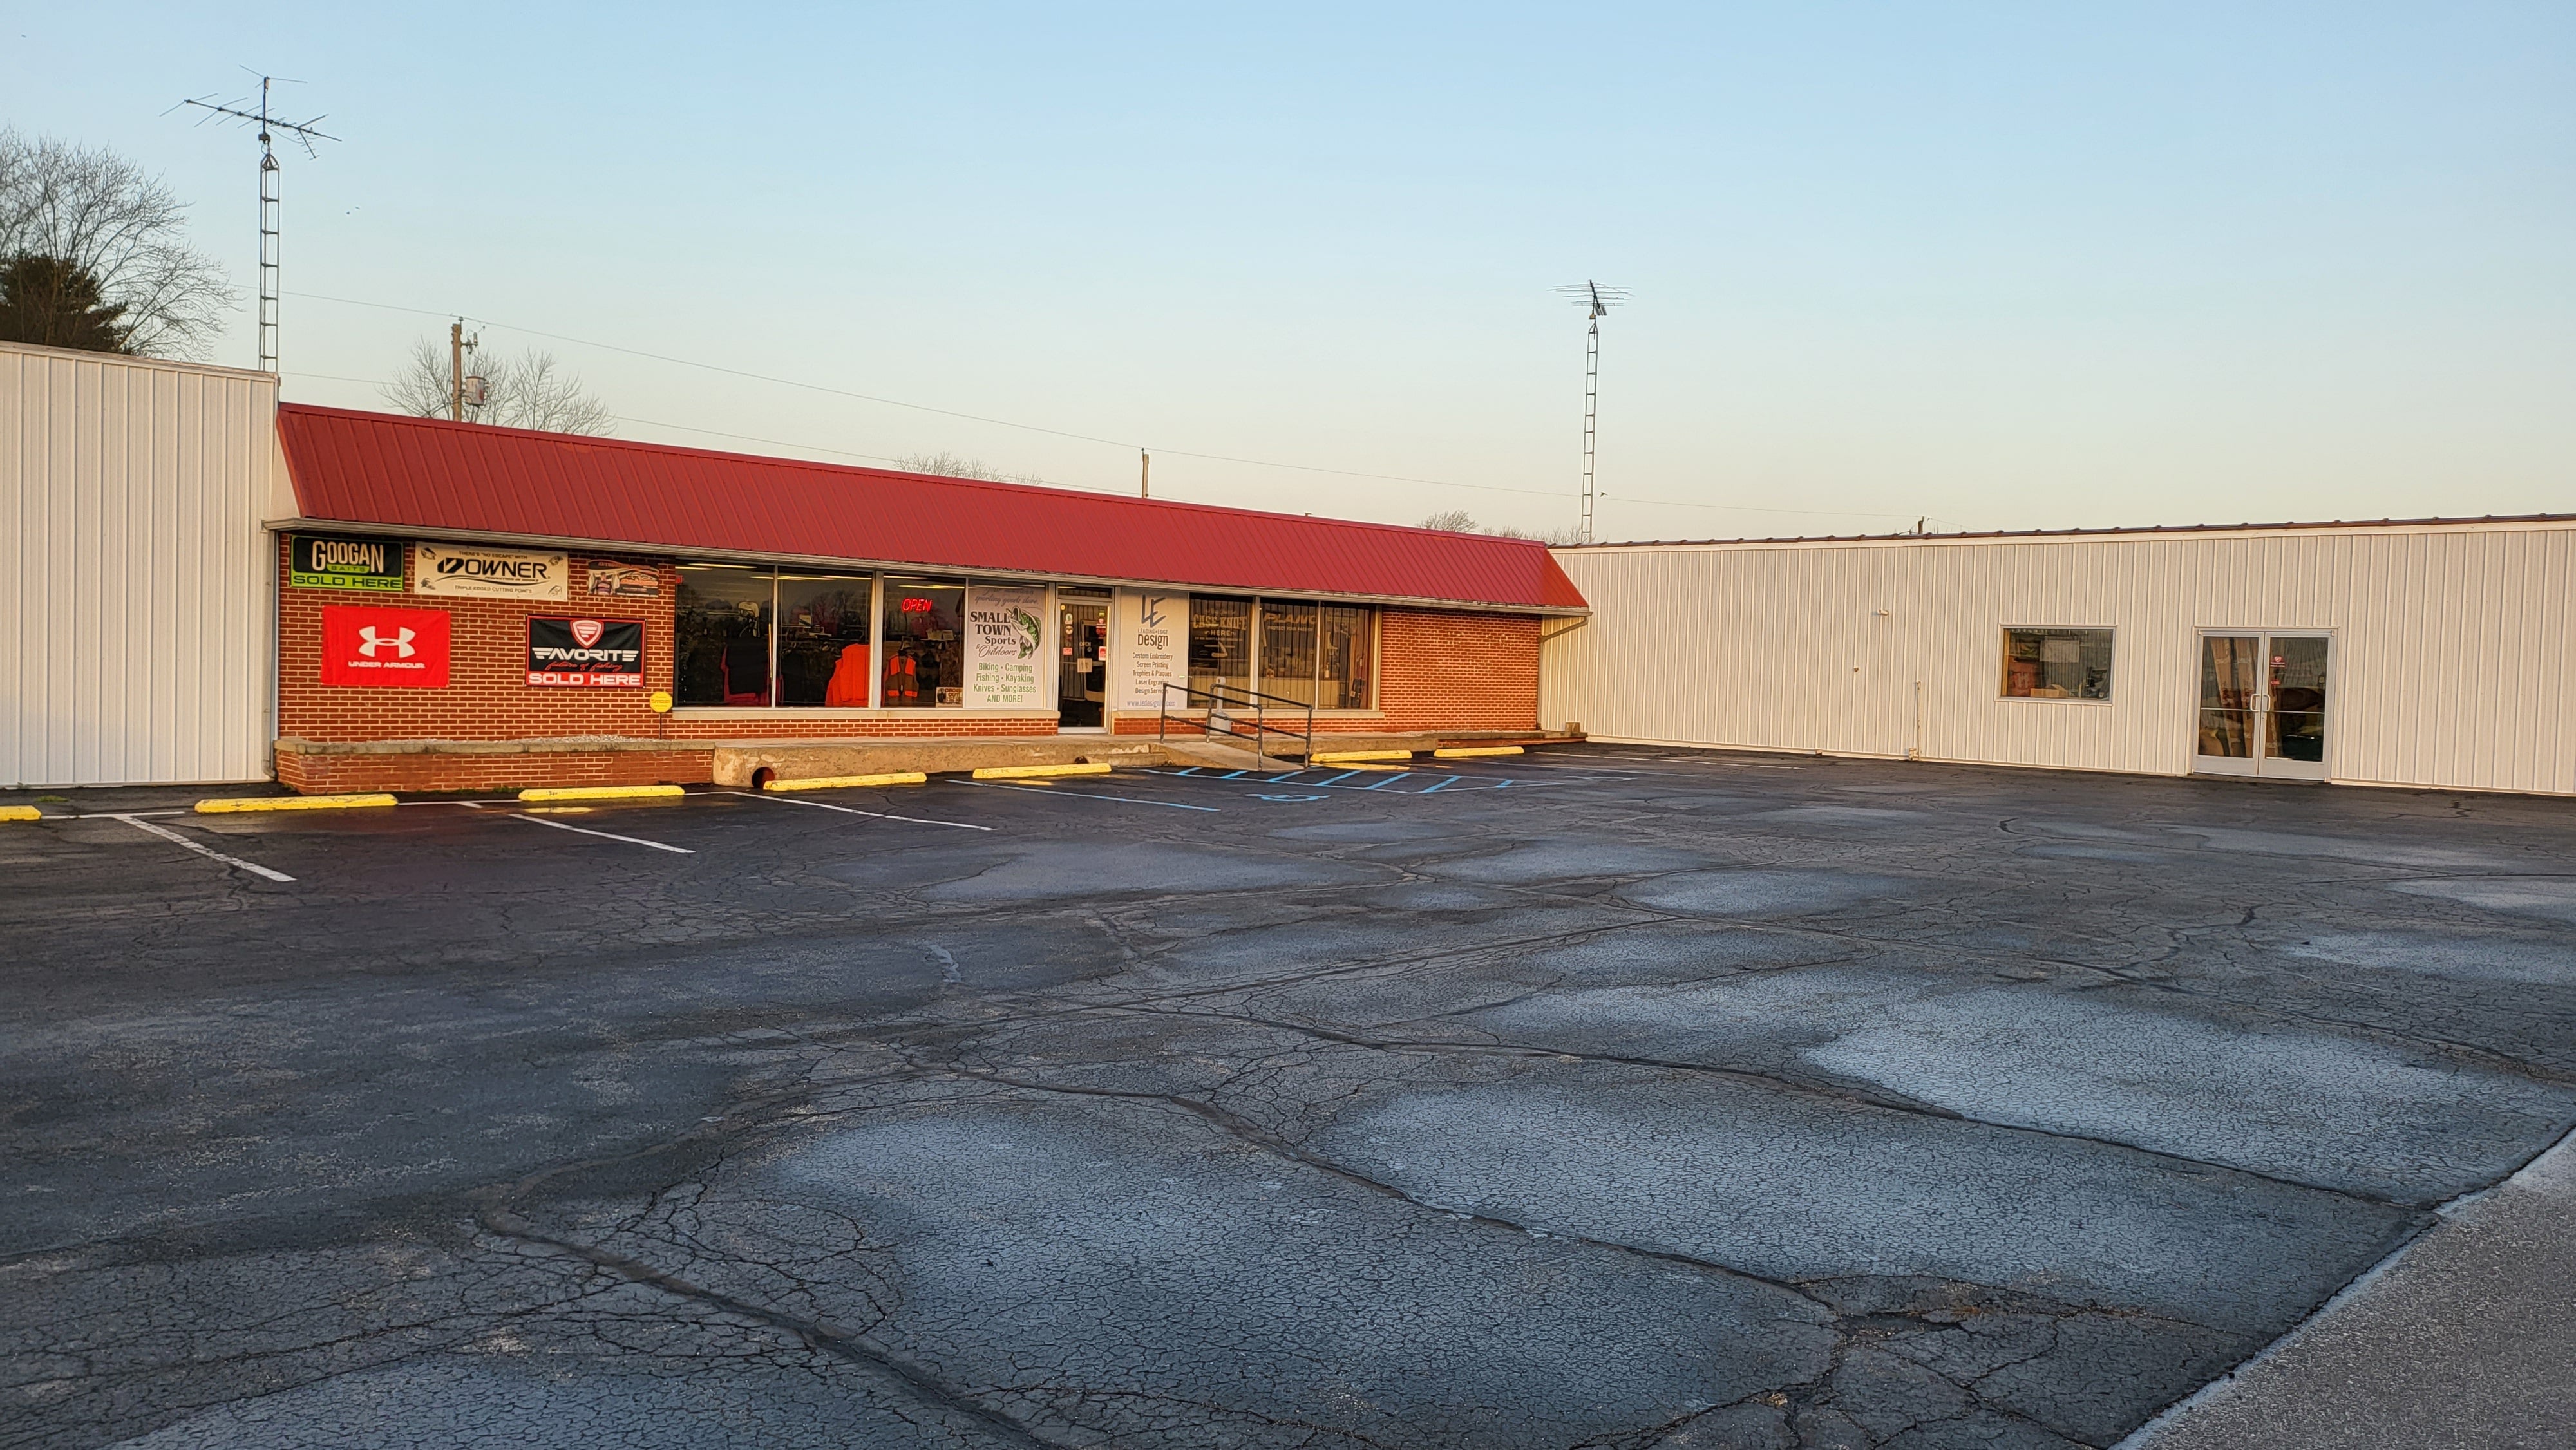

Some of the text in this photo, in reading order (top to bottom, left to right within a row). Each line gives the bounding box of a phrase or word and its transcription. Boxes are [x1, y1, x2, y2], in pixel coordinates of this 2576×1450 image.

[312, 540, 384, 573] GOOGAN
[465, 558, 547, 579] OWNER
[293, 575, 402, 588] SOLD HERE
[902, 598, 933, 612] OPEN
[1001, 595, 1021, 607] goods
[969, 611, 1011, 623] SMALL
[1220, 616, 1247, 630] KNIFE
[975, 623, 1011, 636] TOWN
[985, 636, 1016, 646] Sports
[1137, 634, 1168, 650] Design
[532, 647, 639, 662] FAVORITE
[979, 644, 1018, 658] Outdoors
[1150, 652, 1173, 661] Embroidery
[978, 662, 1033, 673] Biking Camping
[1152, 661, 1169, 670] Printing
[529, 673, 641, 686] SOLD HERE
[976, 673, 1034, 684] Fishing Kayaking
[973, 683, 1036, 693] Knives Sunglasses
[987, 694, 1023, 703] AND MORE!
